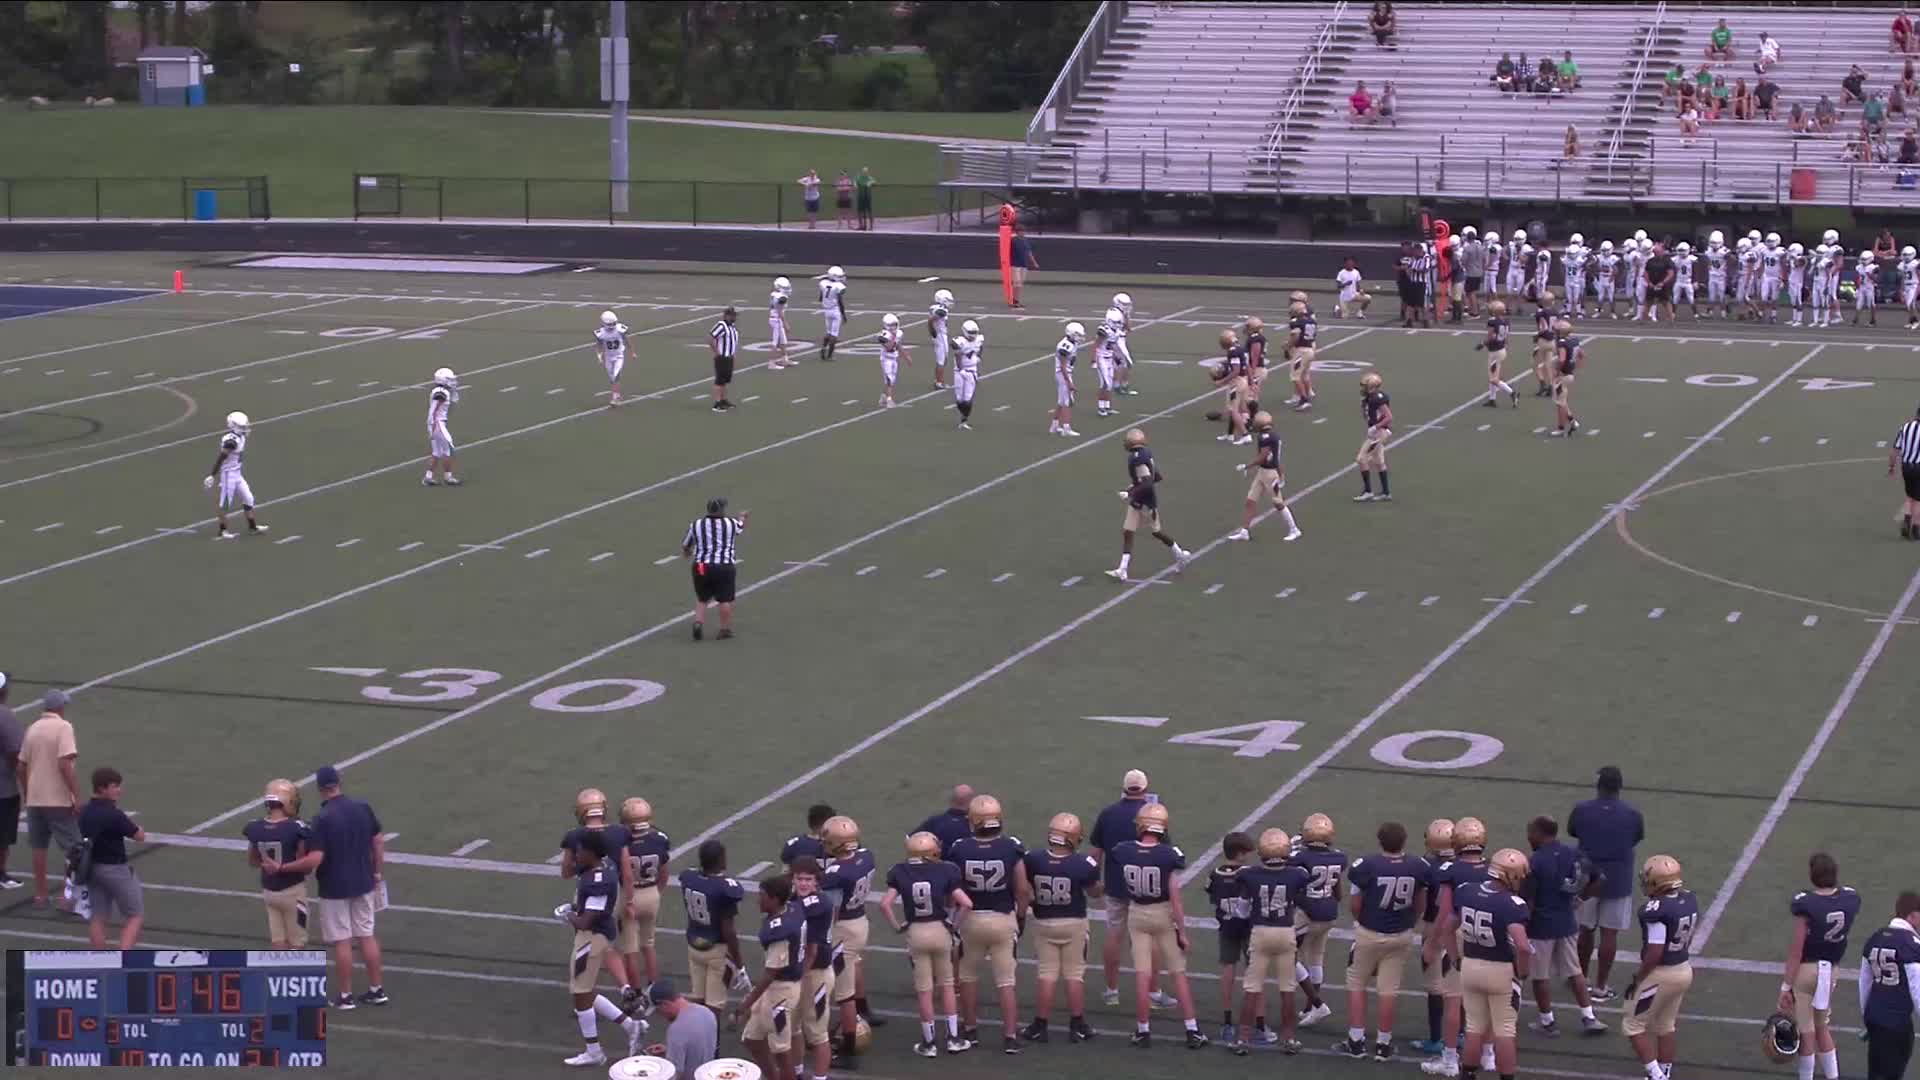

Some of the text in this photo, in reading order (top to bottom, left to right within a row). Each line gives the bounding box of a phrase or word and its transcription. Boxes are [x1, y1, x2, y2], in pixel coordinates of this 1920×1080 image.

[359, 668, 666, 713] 30
[1167, 719, 1504, 770] 40
[964, 859, 1006, 893] 52
[1376, 876, 1416, 911] 79
[912, 881, 933, 917] 9
[1259, 884, 1288, 919] 14
[1823, 911, 1846, 944] 2
[1868, 947, 1900, 986] 15
